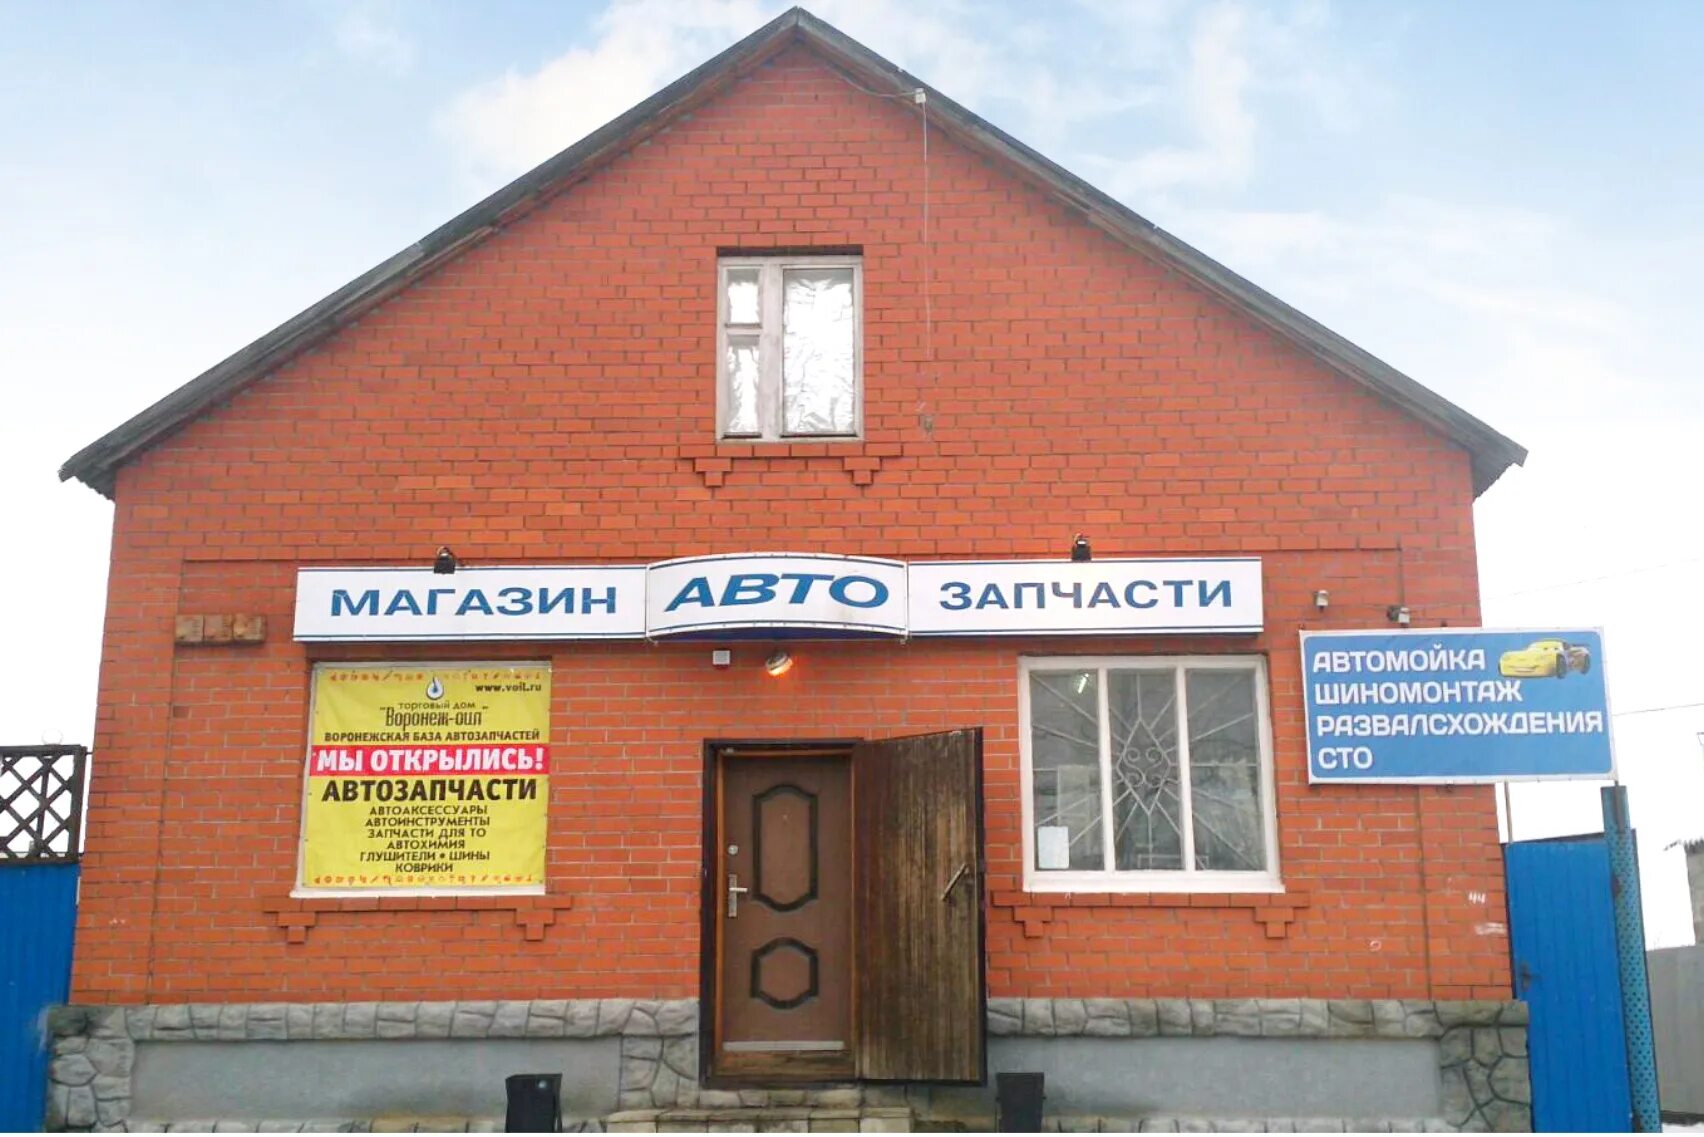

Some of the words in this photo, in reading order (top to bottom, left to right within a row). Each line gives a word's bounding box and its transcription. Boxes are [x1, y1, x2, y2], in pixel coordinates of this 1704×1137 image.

[330, 586, 616, 617] МАГАЗИН
[664, 574, 890, 612] АВТО
[939, 579, 1232, 610] ЗАПЧАСТИ
[1313, 644, 1485, 673] АВТОМОЙКА
[1315, 680, 1523, 705] ШИНОМОНТАЖ
[398, 700, 449, 710] торговый
[452, 702, 476, 710] дом
[1317, 711, 1603, 737] РАЗВАЛСХОЖДЕНИЯ
[325, 732, 410, 742] ВОРОНЕЖСКАЯ
[412, 732, 442, 742] БАЗА
[445, 730, 540, 741] АВТОЗАПЧАСТЕЙ
[317, 750, 363, 772] МЫ
[370, 748, 544, 771] ОТКРЫЛИСЬ!
[1318, 746, 1374, 769] СТО
[321, 779, 537, 802] АВТОЗАПЧАСТИ
[369, 805, 488, 815] АВТОАКСЕССУАРЫ
[365, 816, 490, 826] АВТОИНСТРУМЕНТЫ
[368, 828, 434, 838] ЗАПЧАСТИ
[438, 828, 465, 839] ДЛЯ
[470, 827, 486, 837] ТО
[386, 840, 465, 849] АВТОХИМИЯ
[359, 851, 435, 861] ГЛУШИТЕЛИ
[449, 851, 490, 860] ШИНЫ
[395, 862, 454, 872] КОВРИКИ
